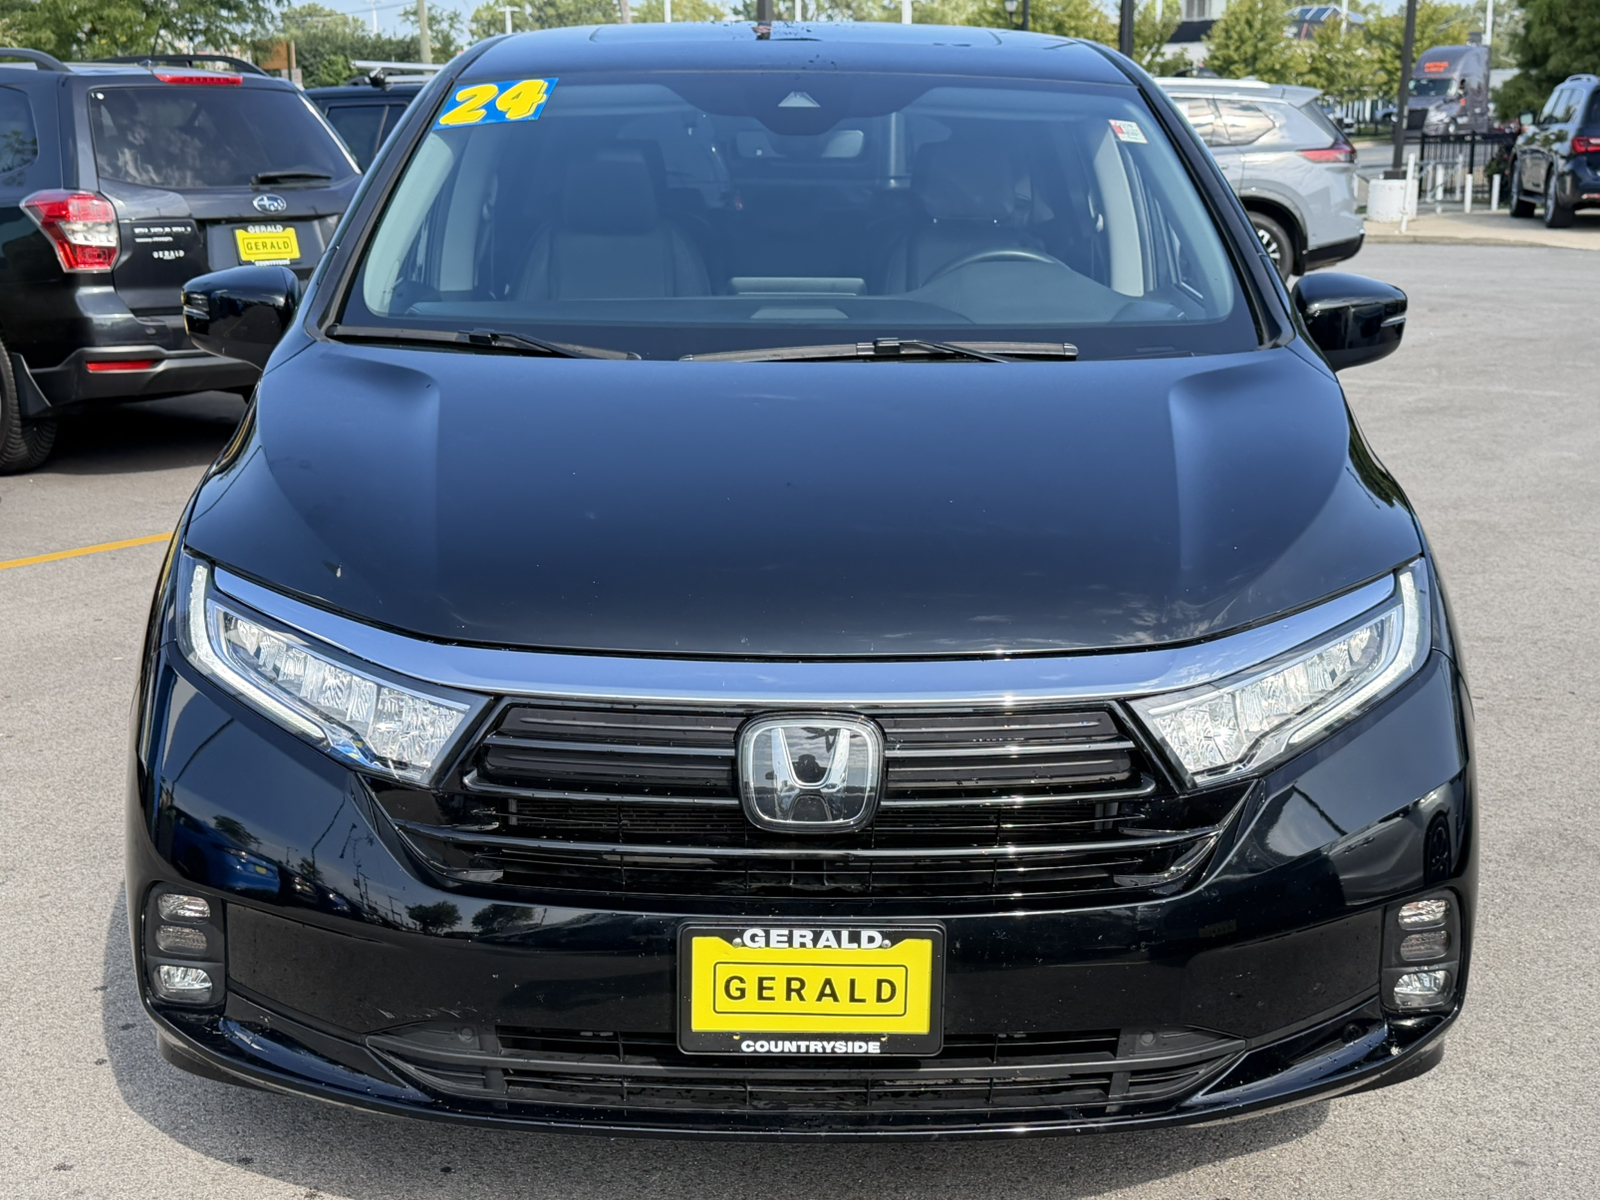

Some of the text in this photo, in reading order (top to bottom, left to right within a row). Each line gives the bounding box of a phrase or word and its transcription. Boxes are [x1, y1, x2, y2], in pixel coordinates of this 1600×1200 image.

[439, 79, 548, 125] 24
[246, 241, 290, 251] GERALD
[742, 928, 883, 950] GERALD
[724, 975, 897, 1004] GERALD
[741, 1040, 881, 1054] COUNTRYSIDE
